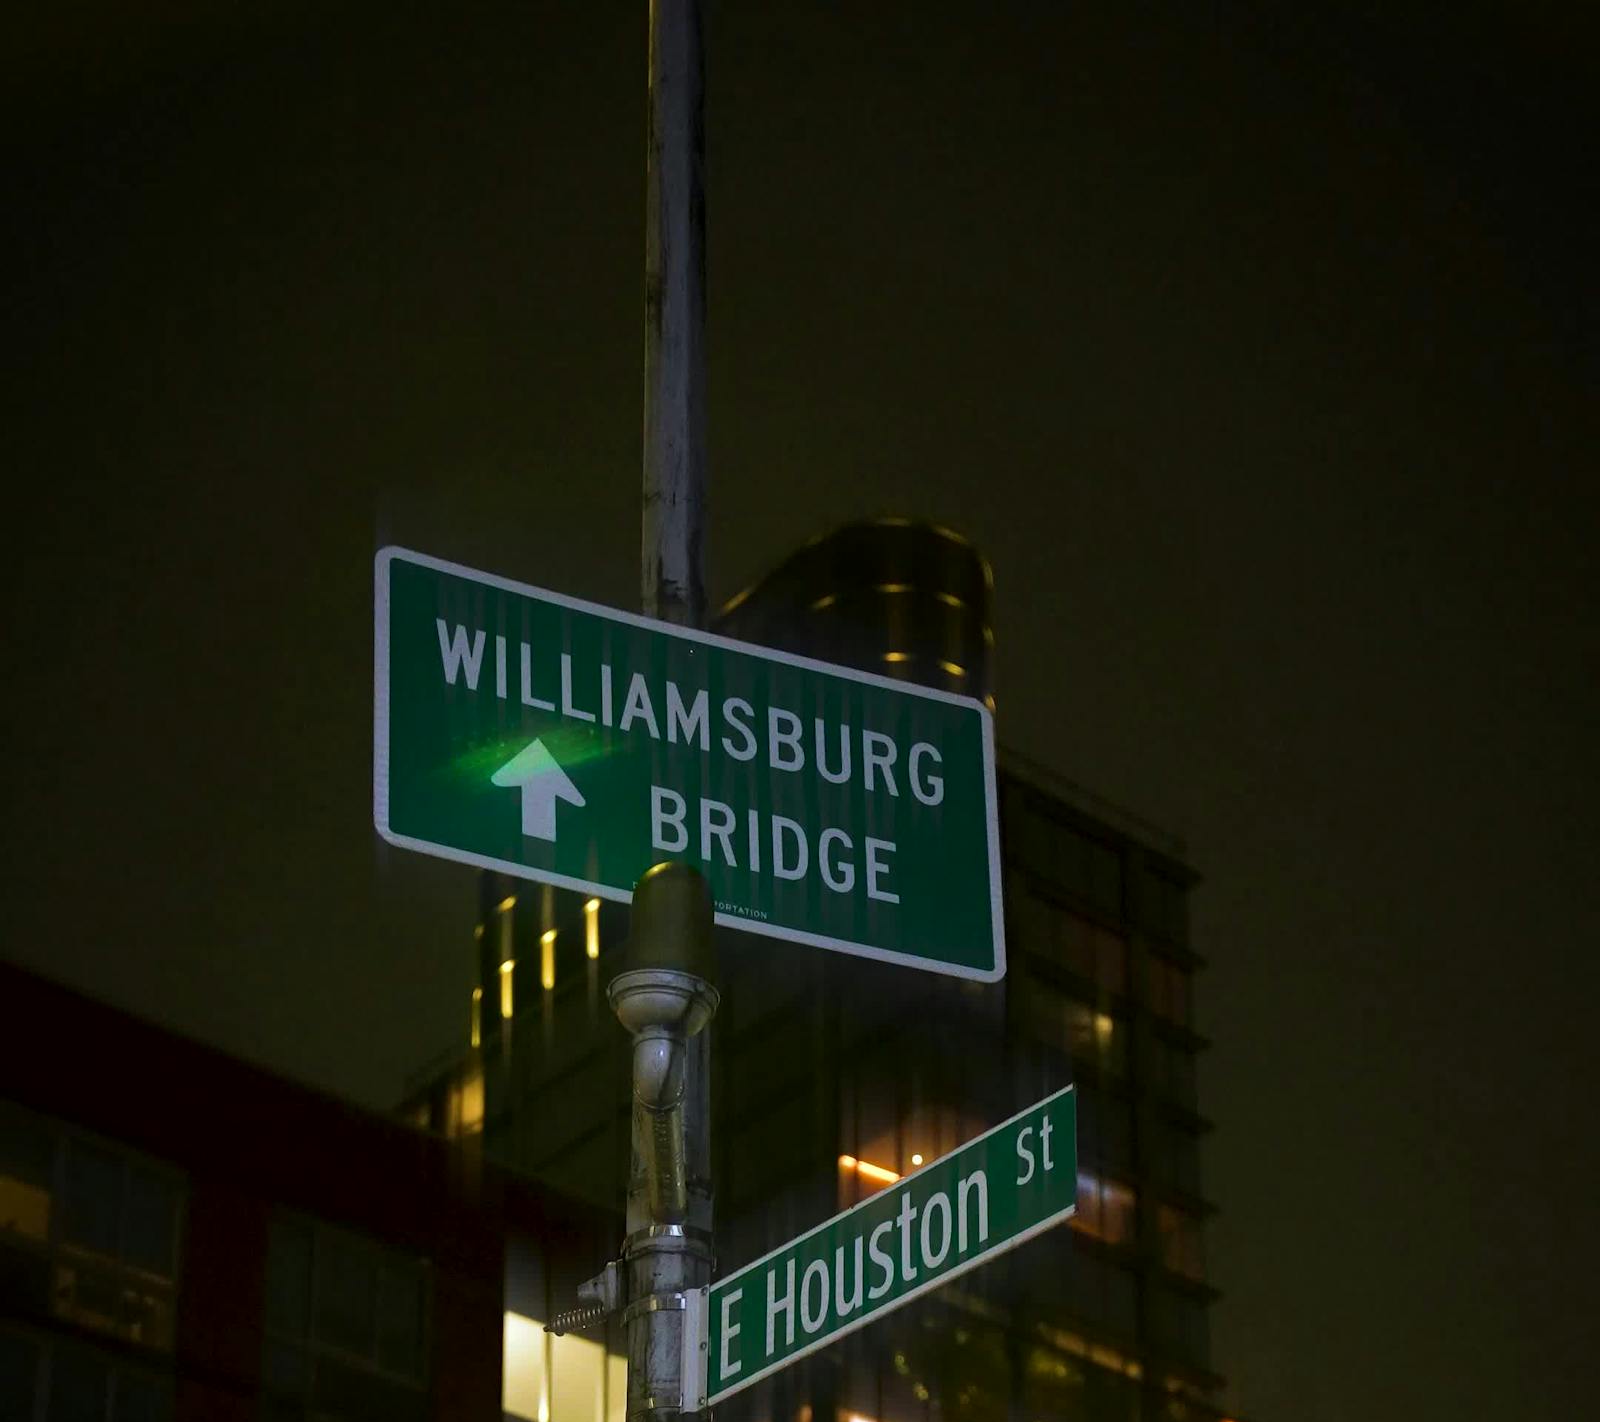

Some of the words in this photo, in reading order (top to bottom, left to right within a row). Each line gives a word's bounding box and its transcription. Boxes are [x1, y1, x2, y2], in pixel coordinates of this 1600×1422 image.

[436, 617, 945, 806] WILLIAMSBURG
[651, 785, 900, 904] BRIDGE
[719, 1287, 743, 1381] E
[765, 1169, 989, 1357] Houston
[1015, 1115, 1054, 1186] St
